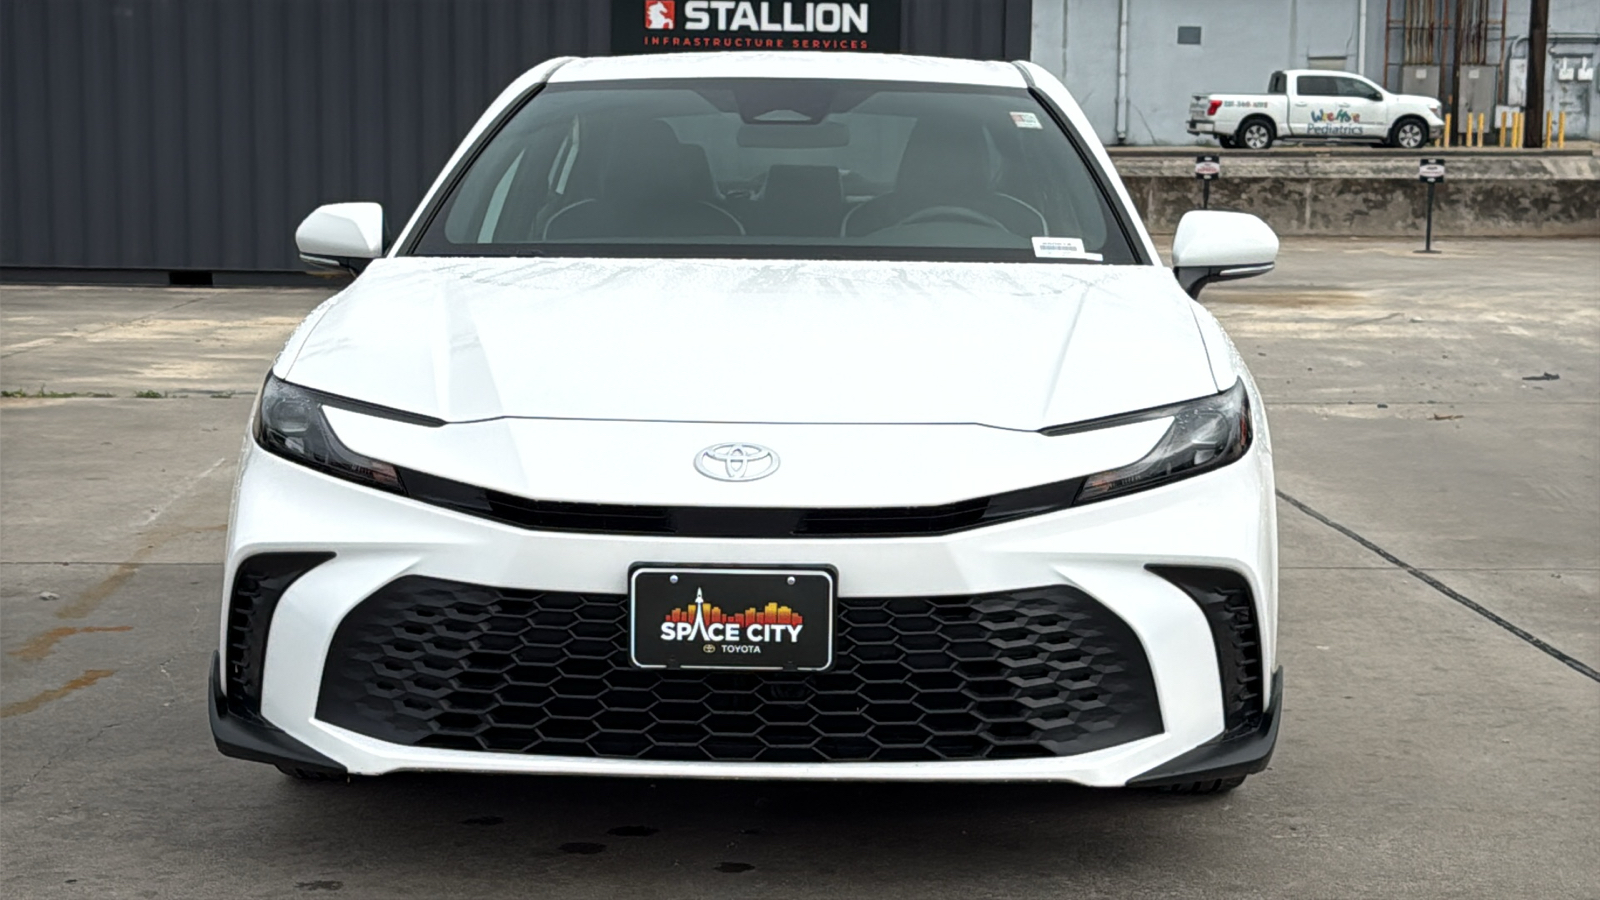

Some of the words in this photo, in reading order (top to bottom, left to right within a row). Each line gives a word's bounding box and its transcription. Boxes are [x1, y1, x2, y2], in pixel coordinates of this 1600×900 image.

[684, 1, 868, 33] STALLION
[644, 36, 784, 48] INFRASTRUCTURE
[792, 39, 868, 49] SERVICES
[1307, 123, 1363, 135] Pediatrics
[660, 621, 740, 642] SPACE
[746, 624, 803, 643] CITY
[721, 645, 761, 654] TOYOTA
